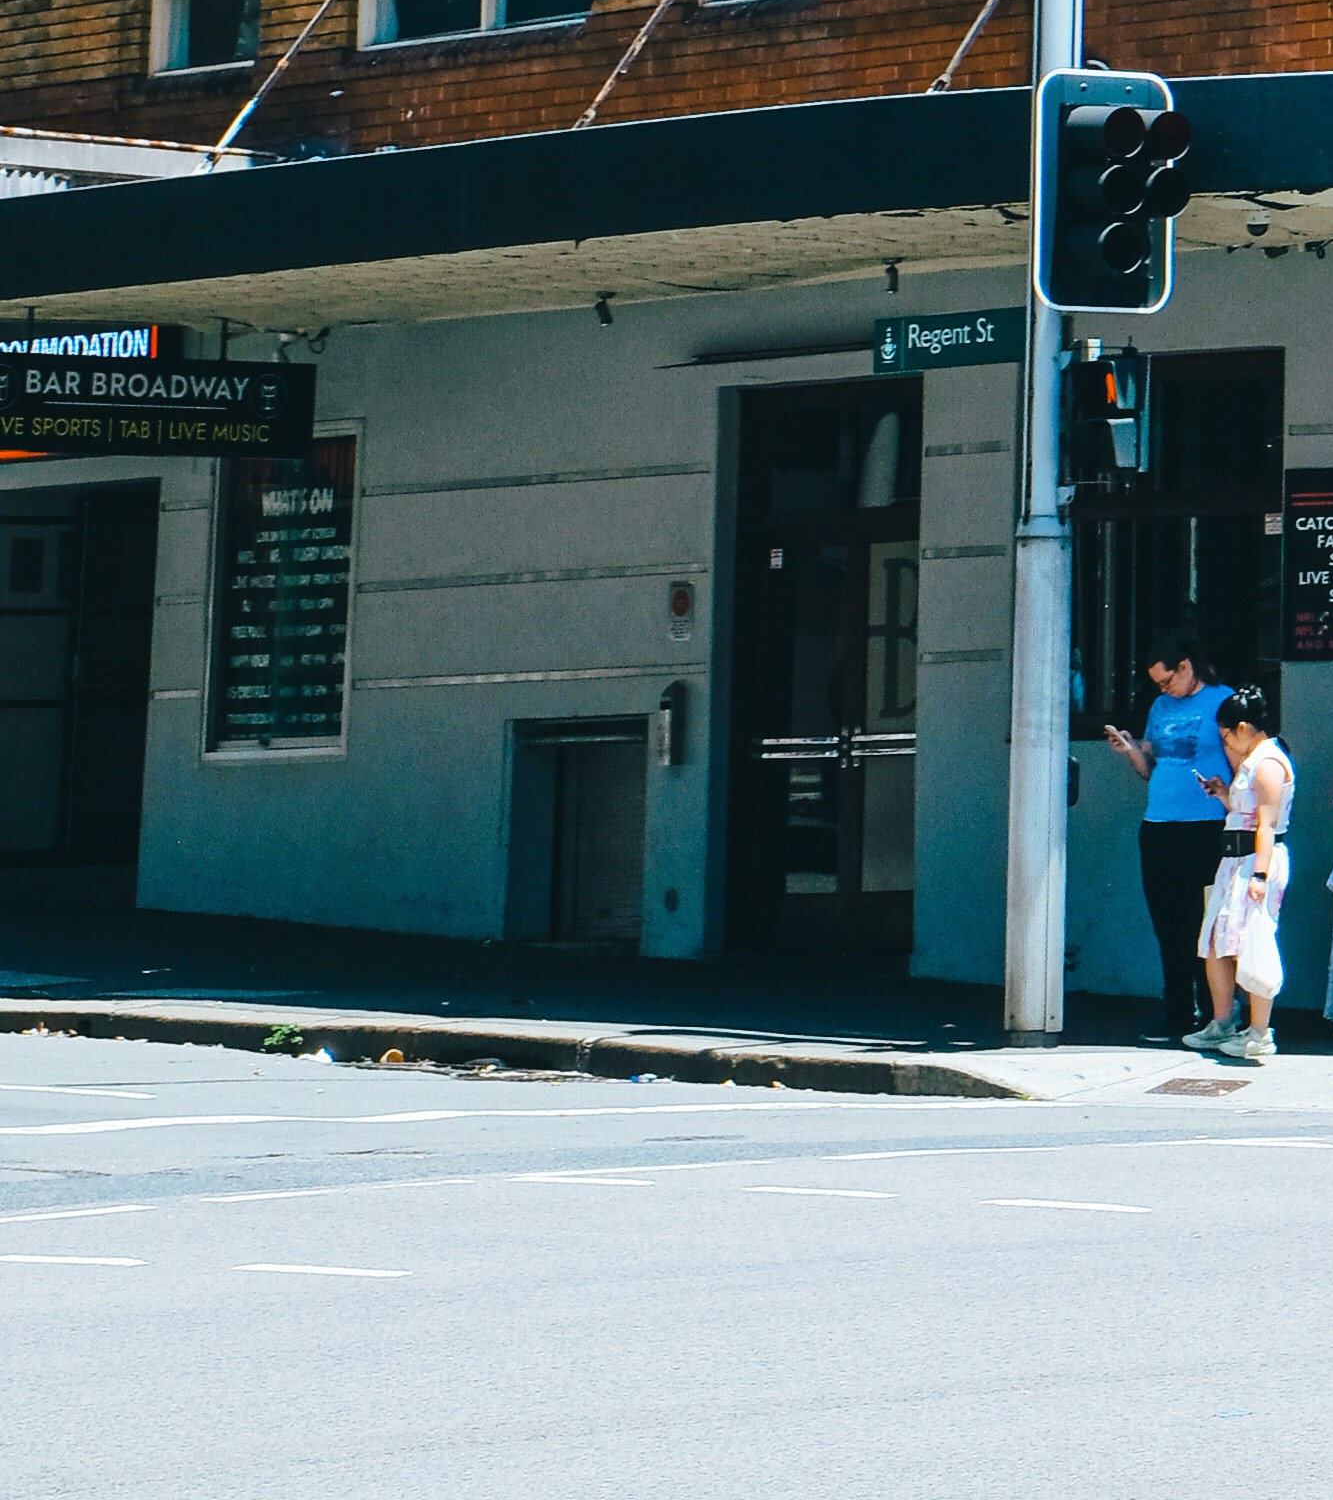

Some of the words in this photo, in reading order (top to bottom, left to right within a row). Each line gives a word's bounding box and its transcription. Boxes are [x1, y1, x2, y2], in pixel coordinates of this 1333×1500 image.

[907, 323, 971, 354] Regent
[975, 317, 995, 343] St
[25, 369, 81, 395] BAR
[91, 372, 250, 400] BROADWAY
[0, 417, 24, 436] VE
[32, 417, 101, 438] SPORTS
[120, 420, 150, 438] TAB
[169, 421, 207, 441] LIVE
[212, 424, 270, 443] MUSIC
[1298, 571, 1330, 585] LIVE
